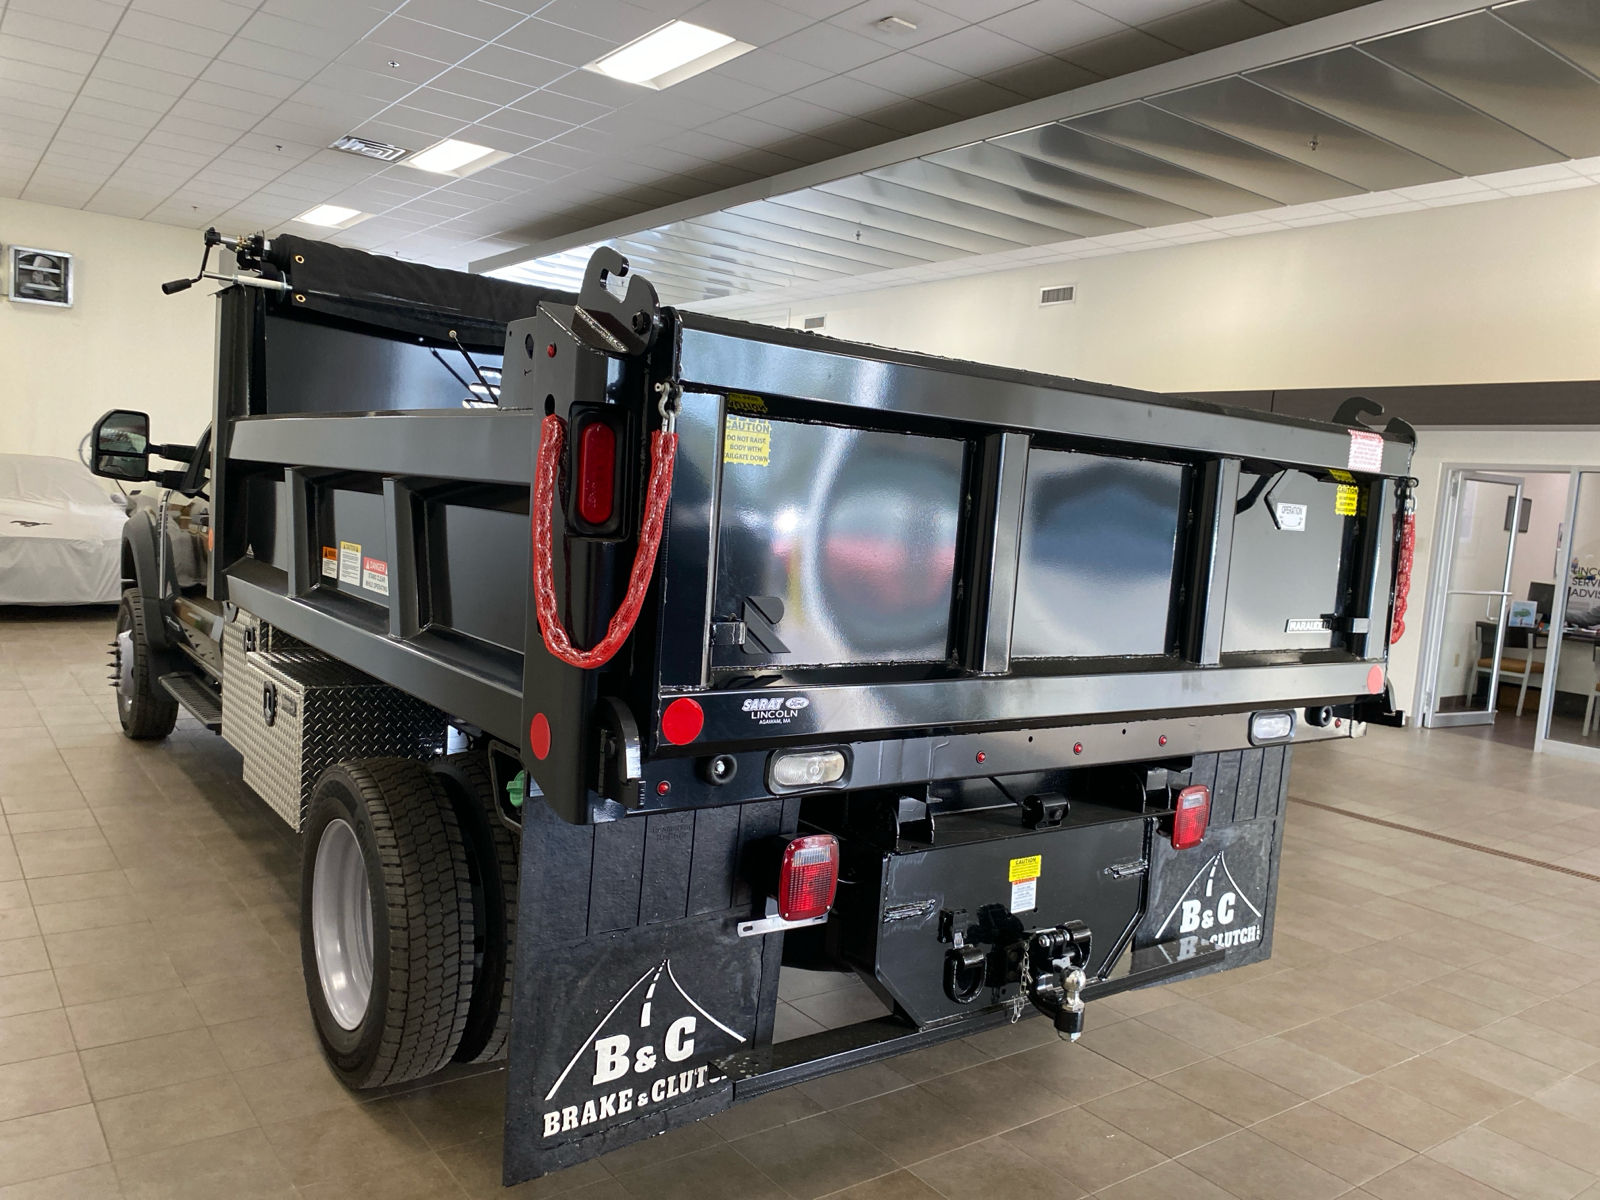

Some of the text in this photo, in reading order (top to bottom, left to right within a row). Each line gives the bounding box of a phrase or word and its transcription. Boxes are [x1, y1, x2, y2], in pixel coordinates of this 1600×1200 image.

[741, 697, 785, 712] SARAT
[751, 710, 798, 719] LINCOLN
[1015, 857, 1037, 865] CAUTION
[542, 1064, 728, 1138] BRAKE & CLUT
